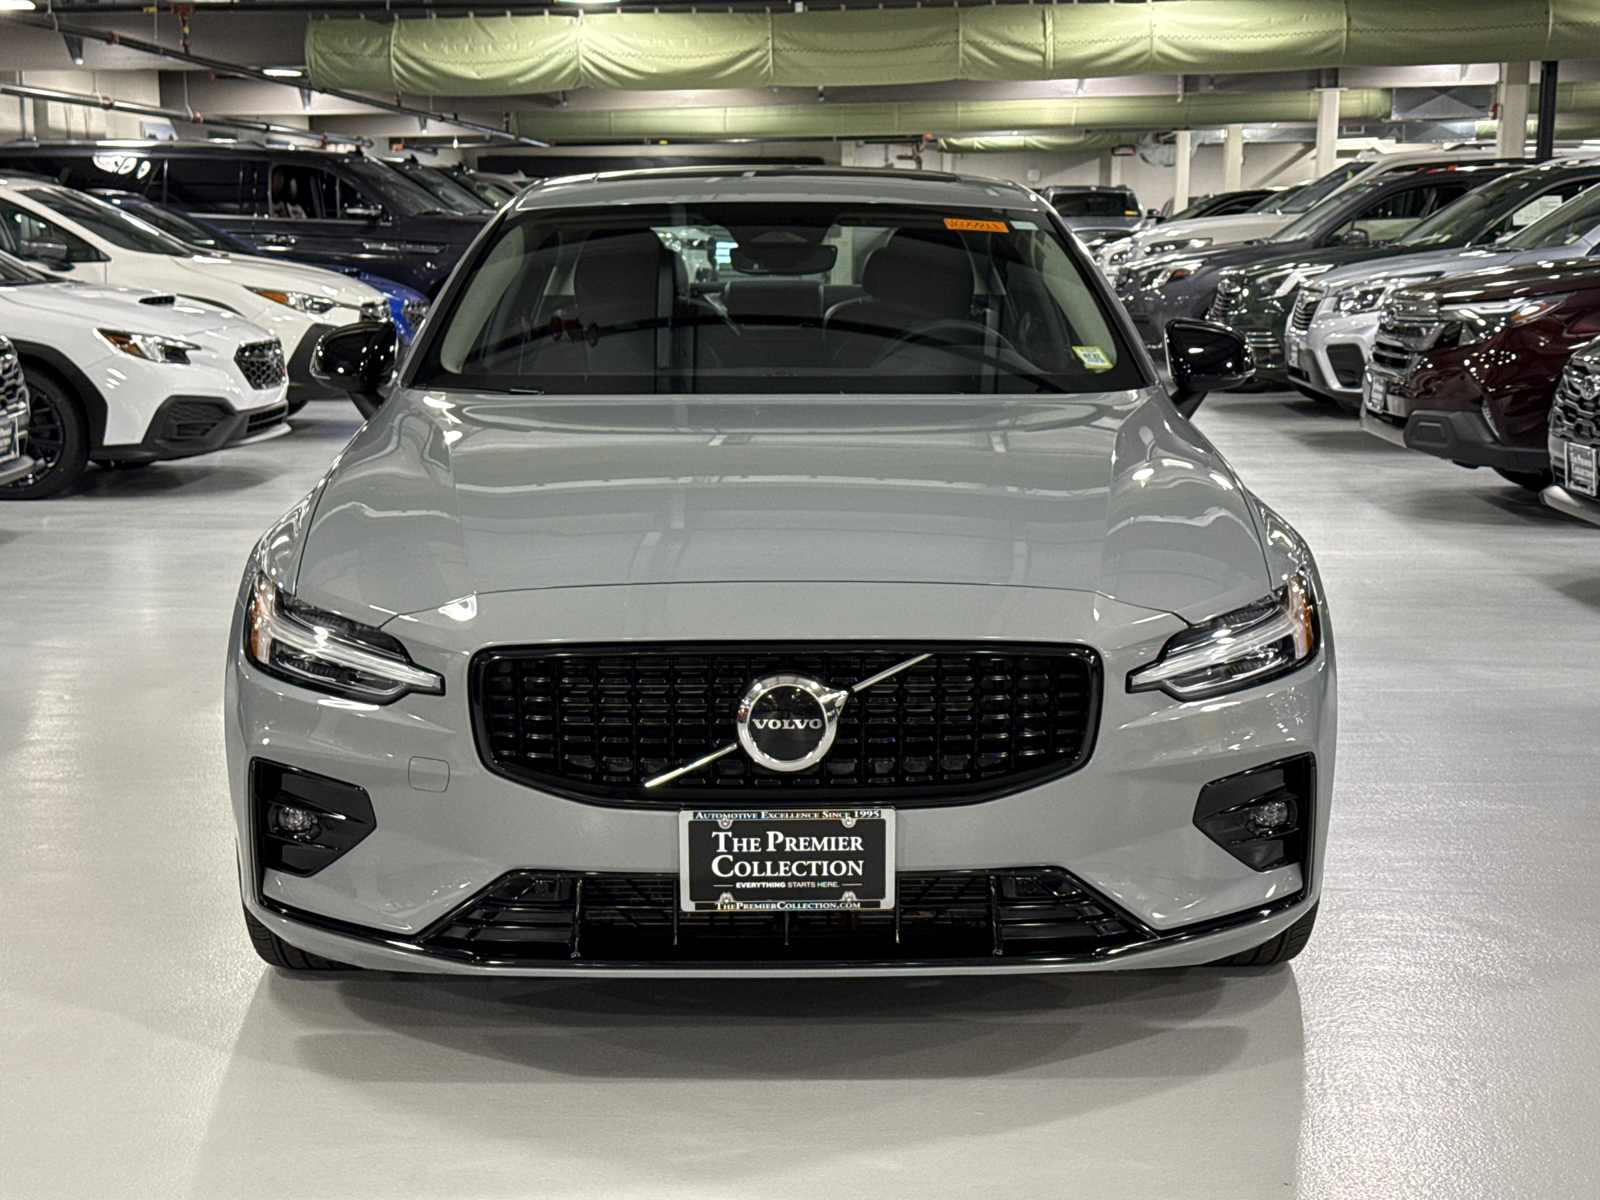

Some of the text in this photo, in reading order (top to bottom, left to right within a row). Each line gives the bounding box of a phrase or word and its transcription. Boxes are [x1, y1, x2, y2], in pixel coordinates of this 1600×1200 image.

[752, 719, 823, 730] VOLVO
[695, 810, 879, 819] AUTOMOTIVE EXCELLENCE SINCE 1995
[711, 831, 864, 852] THE PREMIER
[711, 854, 864, 877] COLLECTION
